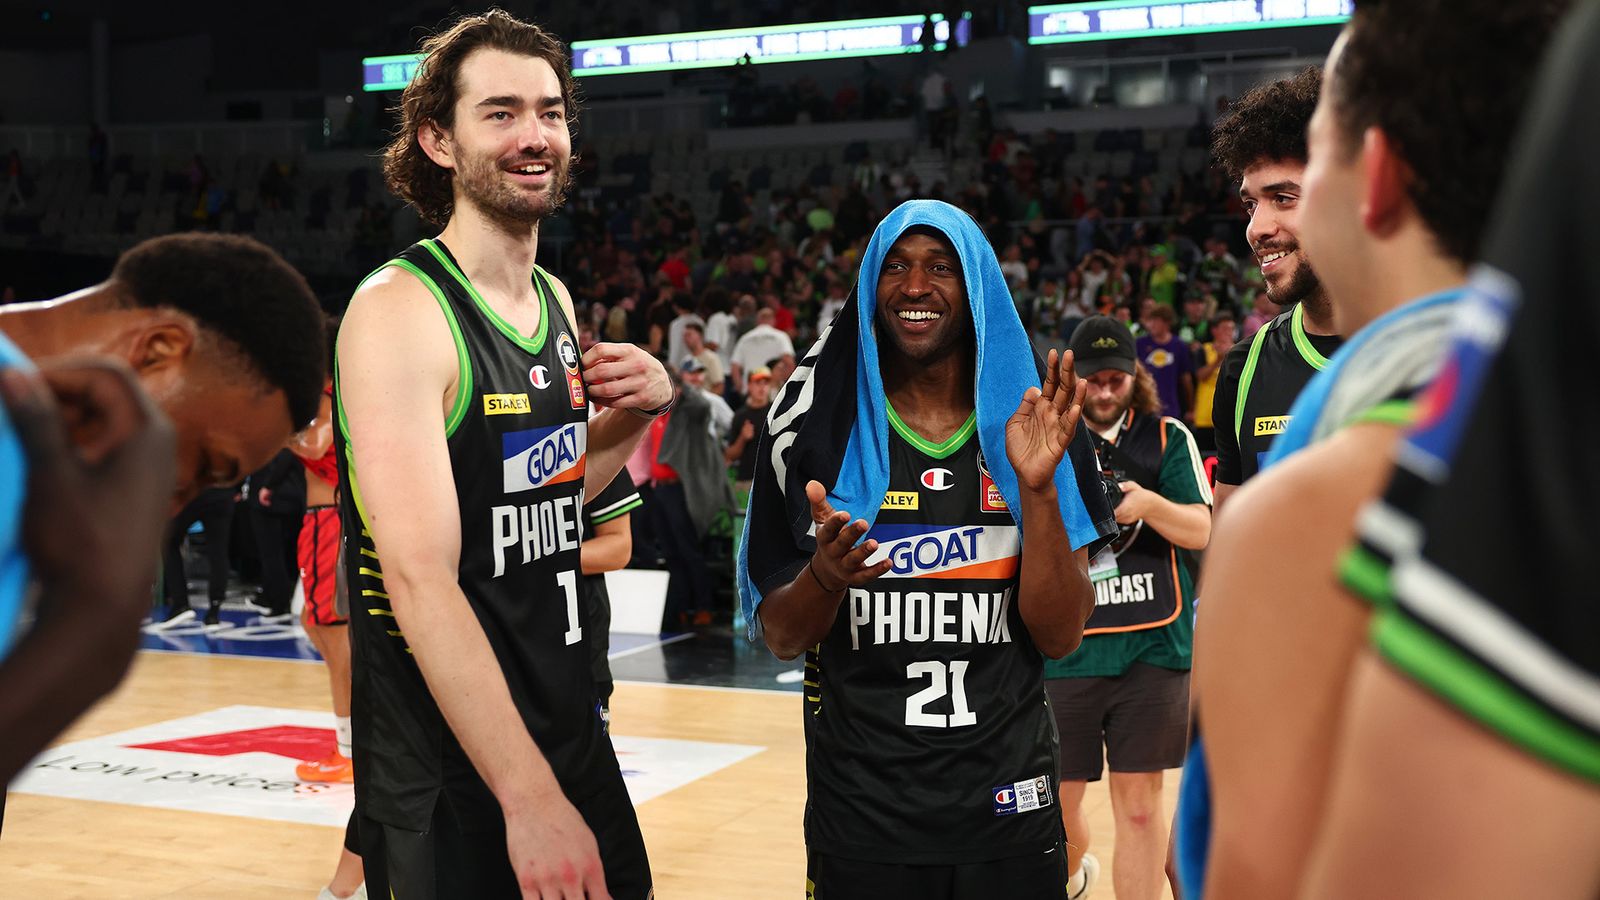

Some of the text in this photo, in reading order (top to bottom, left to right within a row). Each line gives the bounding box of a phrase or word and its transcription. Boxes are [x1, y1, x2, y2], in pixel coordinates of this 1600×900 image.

[1257, 420, 1287, 431] STAN
[527, 425, 578, 485] GOAT
[881, 495, 914, 506] NLEY
[888, 527, 984, 575] GOAT
[556, 569, 583, 646] 1
[905, 660, 977, 728] 21
